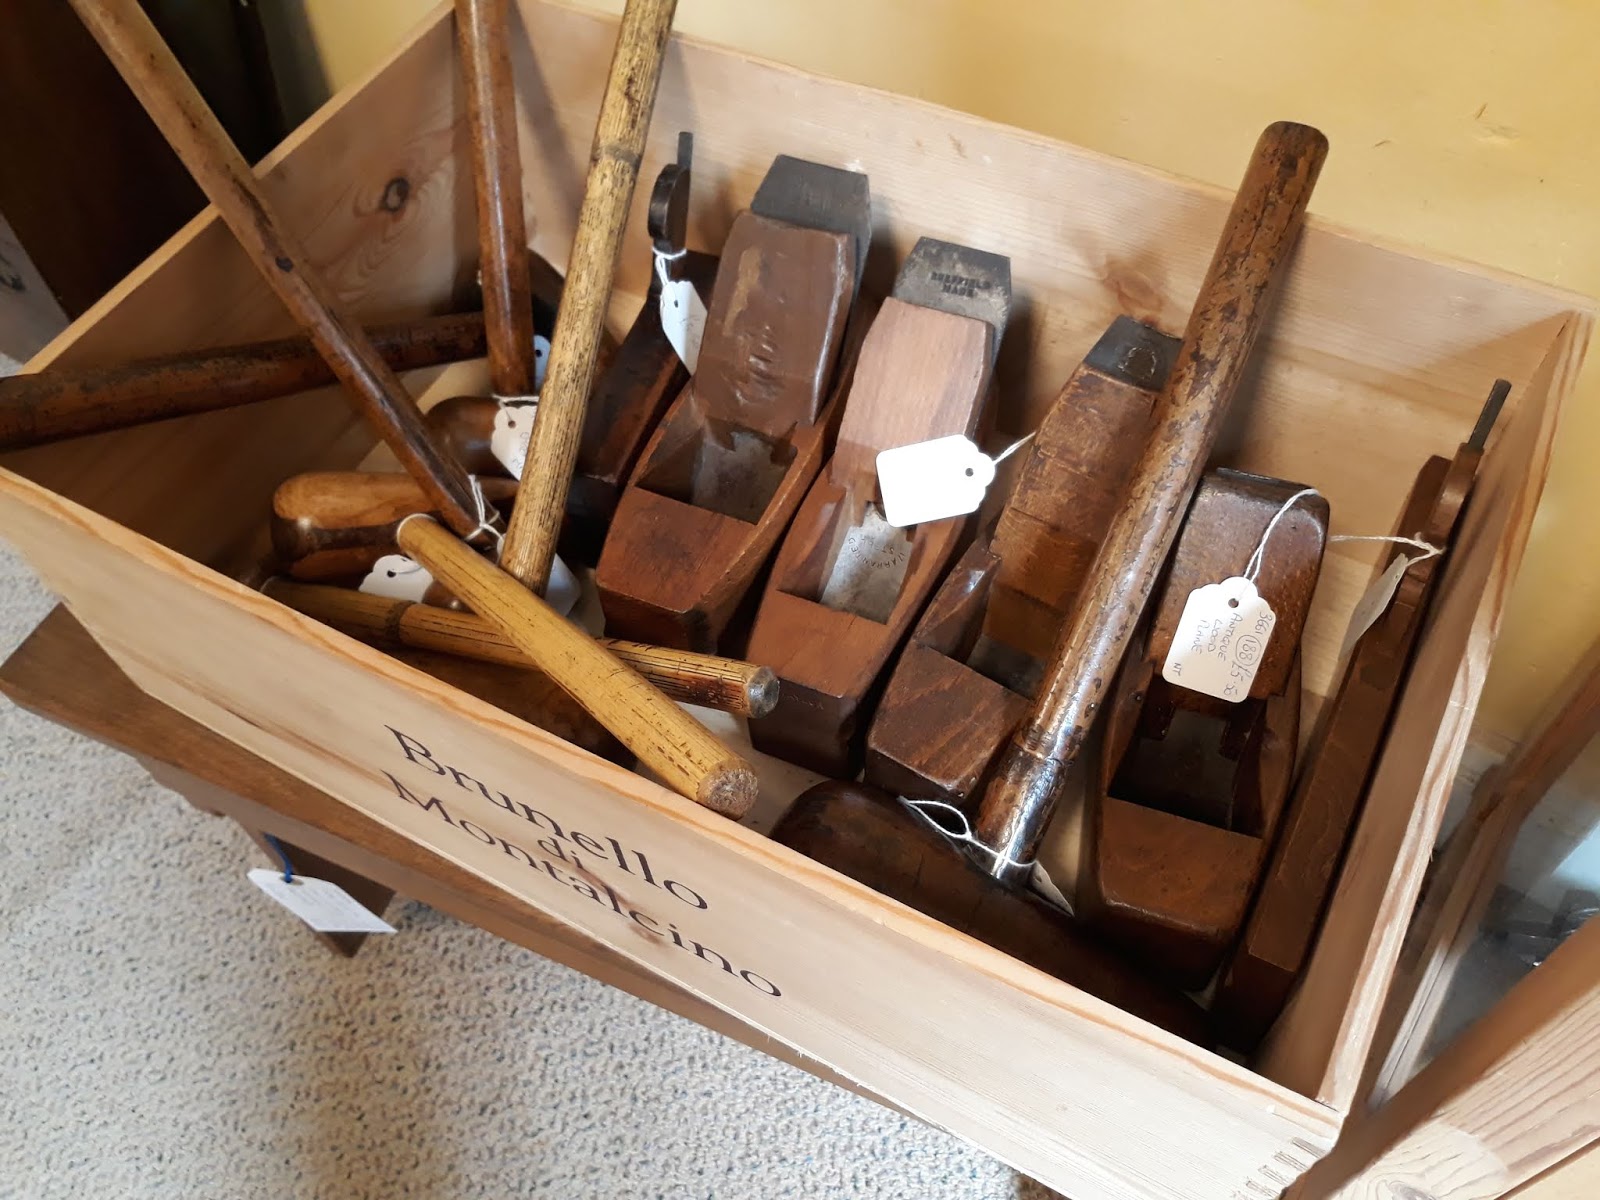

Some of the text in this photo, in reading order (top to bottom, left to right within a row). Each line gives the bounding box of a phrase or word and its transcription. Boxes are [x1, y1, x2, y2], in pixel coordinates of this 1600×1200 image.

[1191, 619, 1210, 655] PLANE
[1207, 618, 1223, 652] WOOD
[1217, 612, 1243, 661] ANTIQUE
[1254, 611, 1273, 635] 3661
[1238, 638, 1258, 661] 188
[383, 724, 709, 910] Brunello
[537, 837, 584, 869] di
[380, 769, 782, 998] Montalcino
